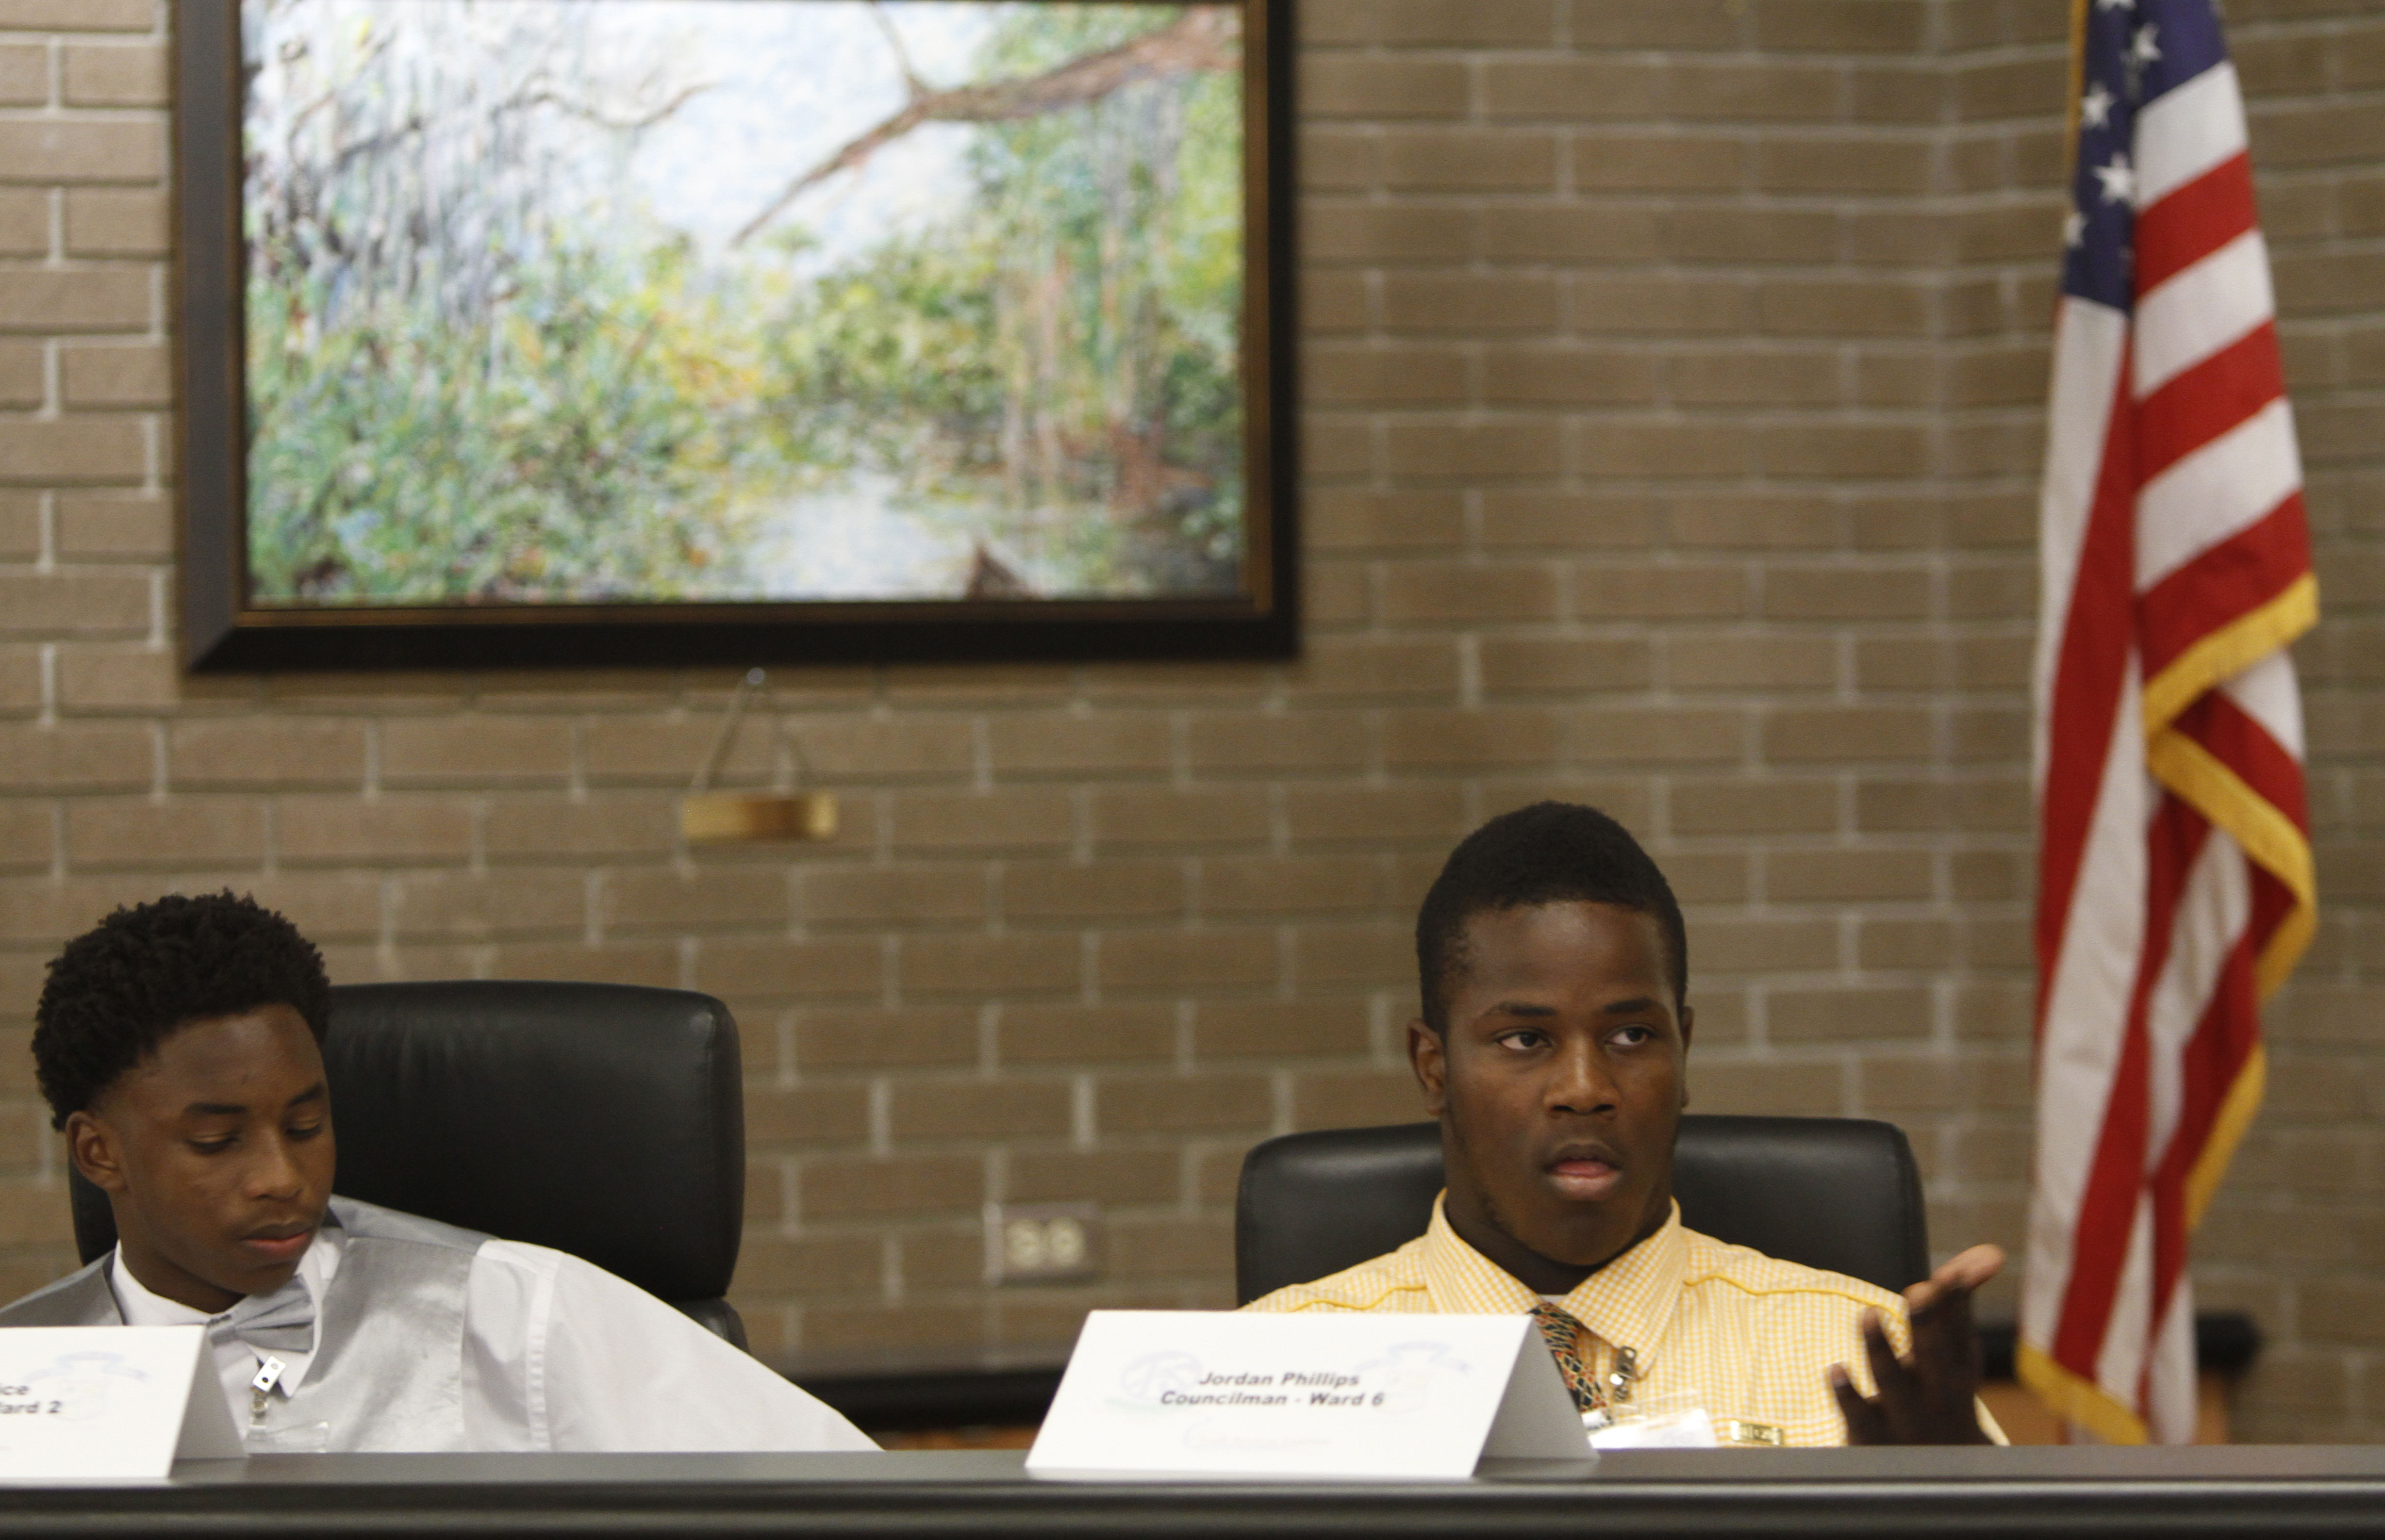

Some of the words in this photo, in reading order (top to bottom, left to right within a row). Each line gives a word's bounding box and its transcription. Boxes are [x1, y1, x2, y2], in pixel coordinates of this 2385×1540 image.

[1198, 1372, 1274, 1386] Jordan
[1280, 1372, 1360, 1389] Phillips
[0, 1401, 41, 1414] ard
[48, 1400, 63, 1414] 2
[1160, 1390, 1288, 1406] Councilman
[1309, 1393, 1365, 1406] Ward
[1371, 1392, 1384, 1407] 6
